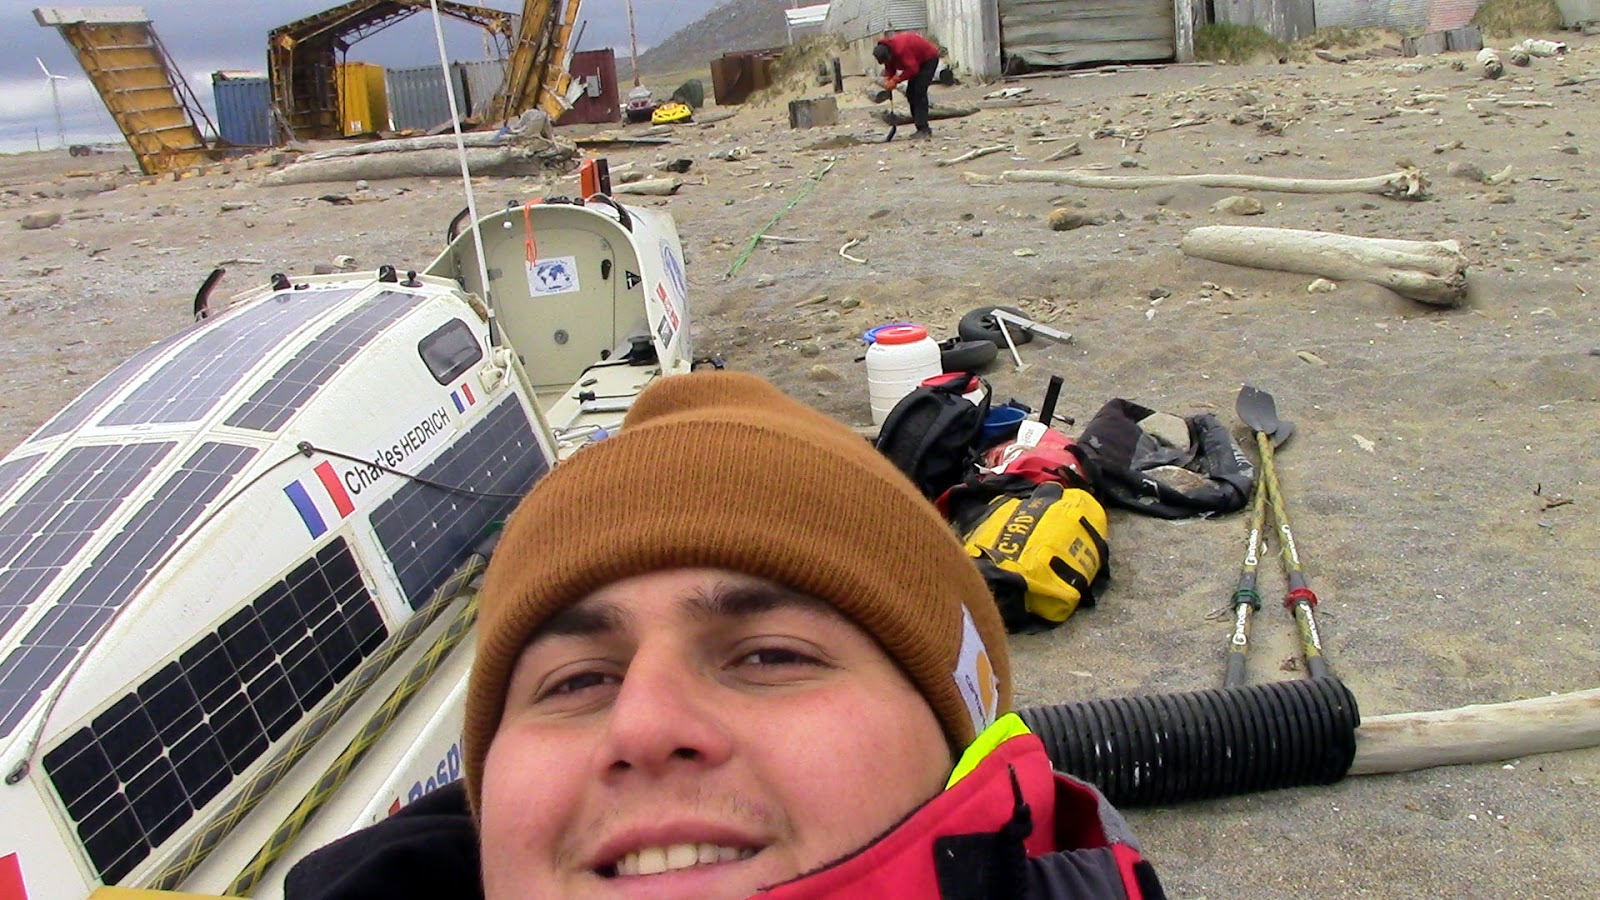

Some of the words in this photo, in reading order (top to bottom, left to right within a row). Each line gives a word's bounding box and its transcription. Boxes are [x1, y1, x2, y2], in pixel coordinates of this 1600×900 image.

[345, 444, 404, 495] Charles
[399, 406, 451, 457] HEDRICH
[408, 733, 464, 804] Resp
